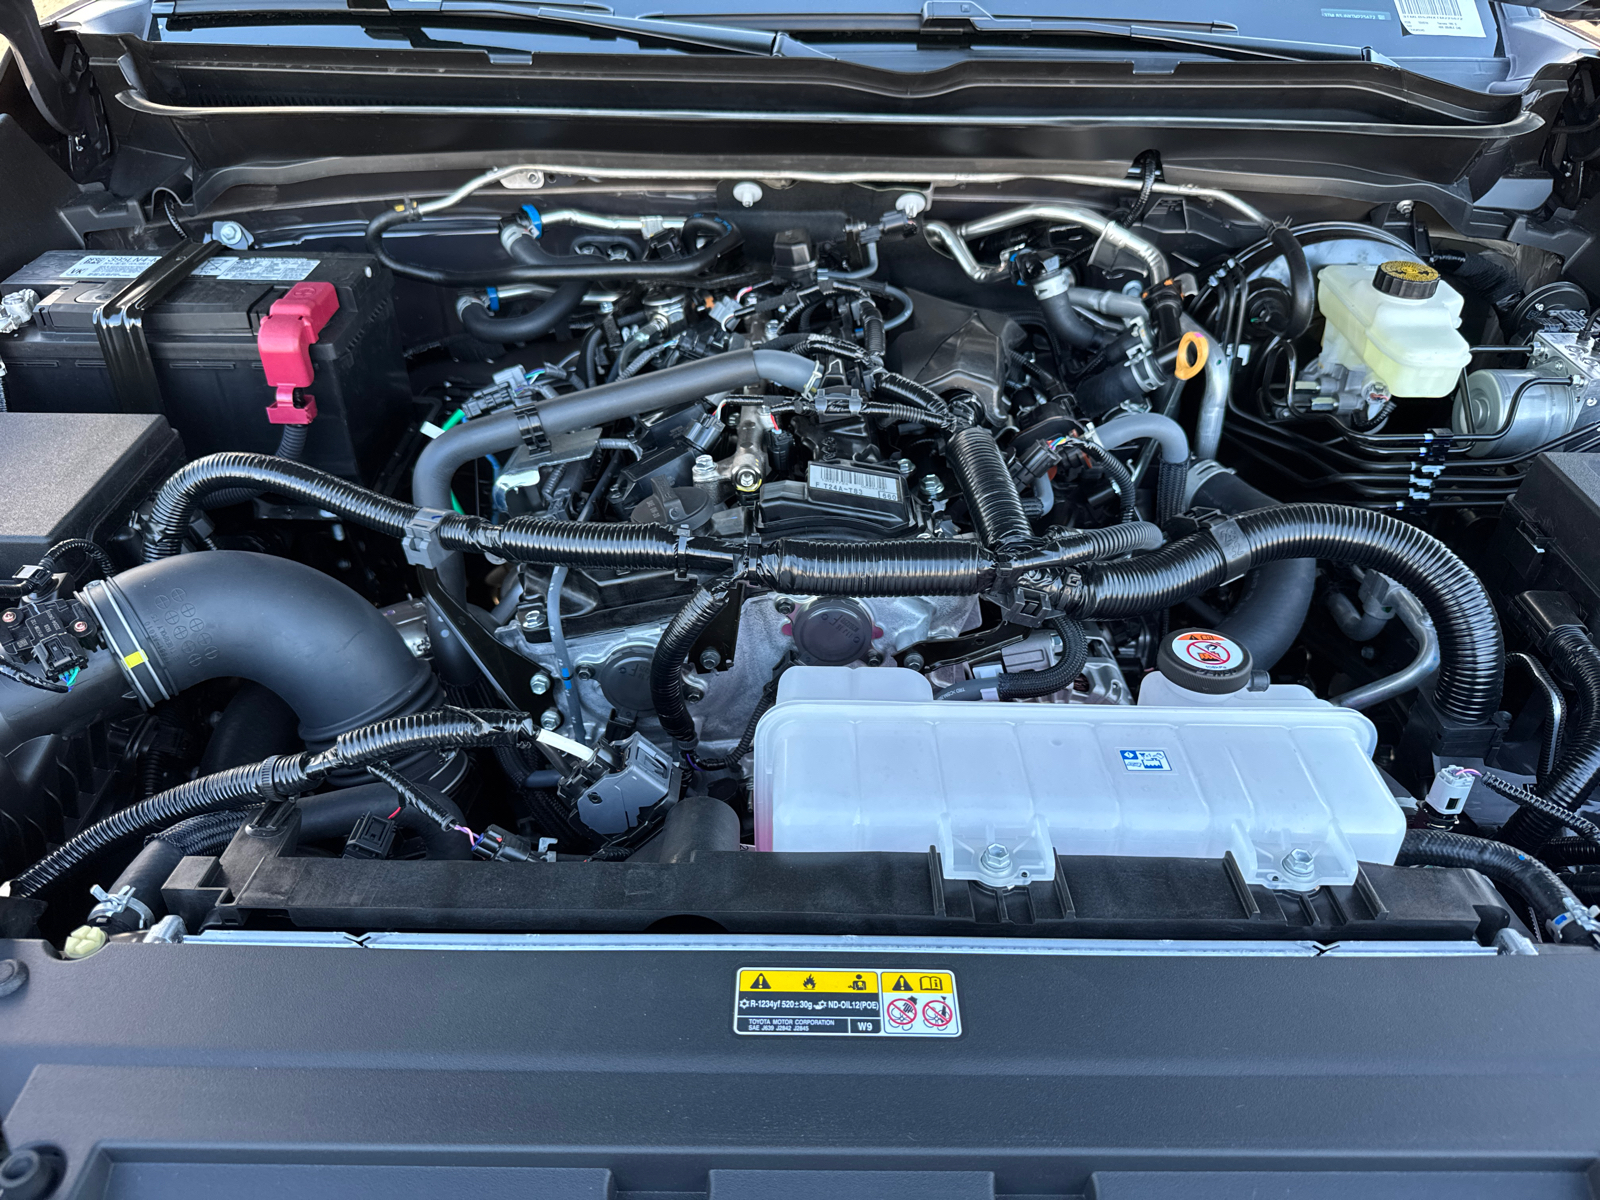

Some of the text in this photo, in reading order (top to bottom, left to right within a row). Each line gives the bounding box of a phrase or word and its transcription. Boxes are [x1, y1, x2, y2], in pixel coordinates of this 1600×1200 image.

[750, 1000, 879, 1011] R-1234yf 520±30g ND-OIL12(POE)
[857, 1022, 873, 1031] W9
